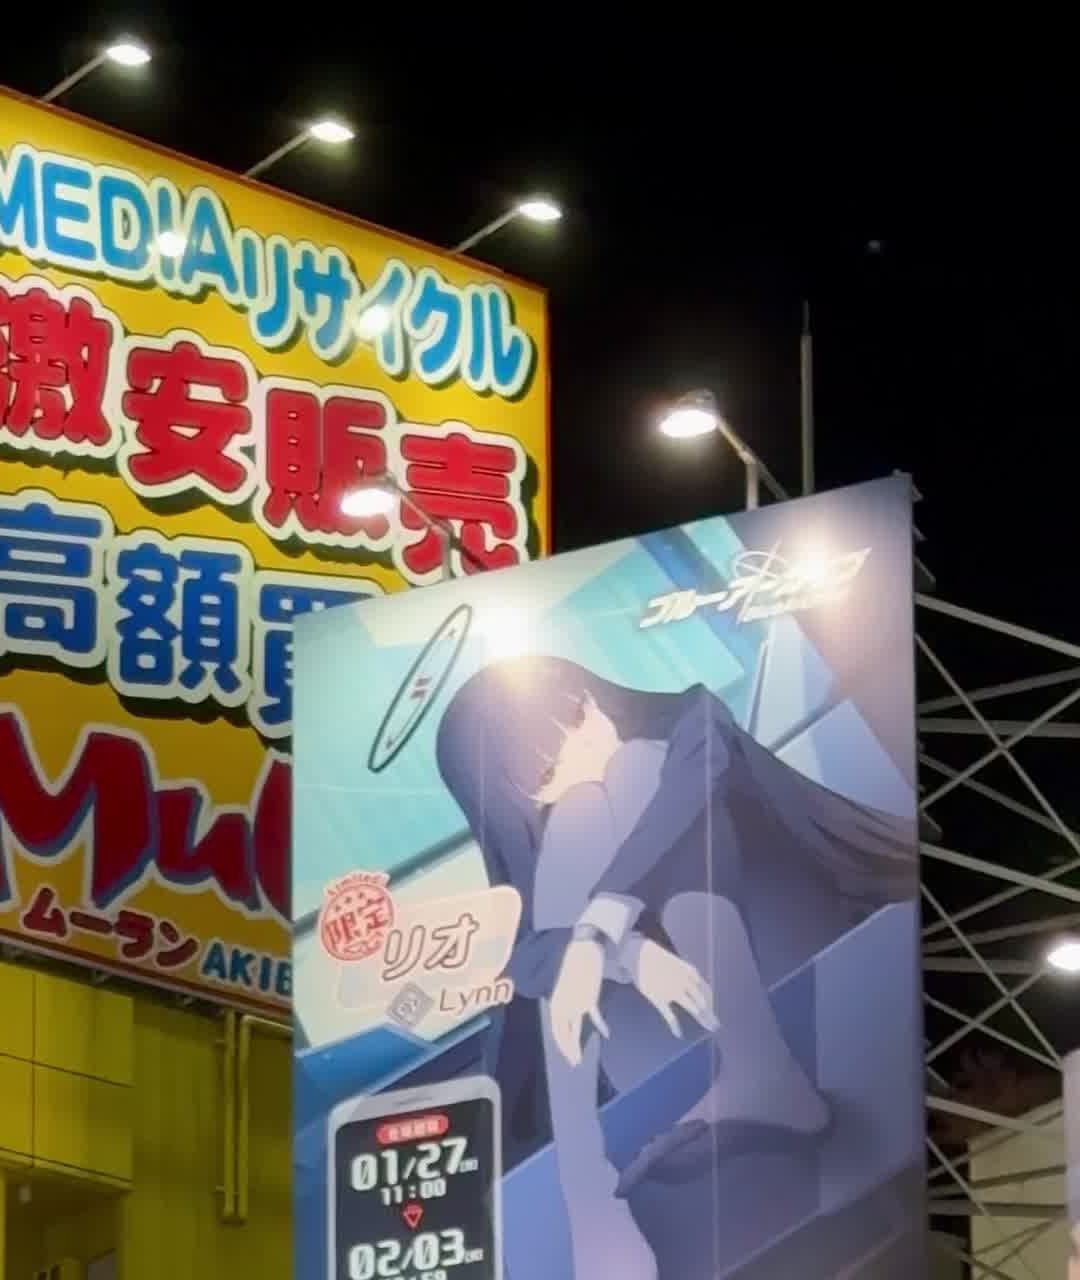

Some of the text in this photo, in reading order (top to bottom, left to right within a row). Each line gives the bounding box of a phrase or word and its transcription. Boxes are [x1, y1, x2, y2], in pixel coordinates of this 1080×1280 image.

[22, 887, 293, 996] ムーラン AKIB
[381, 912, 480, 981] リオ
[439, 983, 510, 1014] Lynn
[381, 1179, 446, 1205] 11:00
